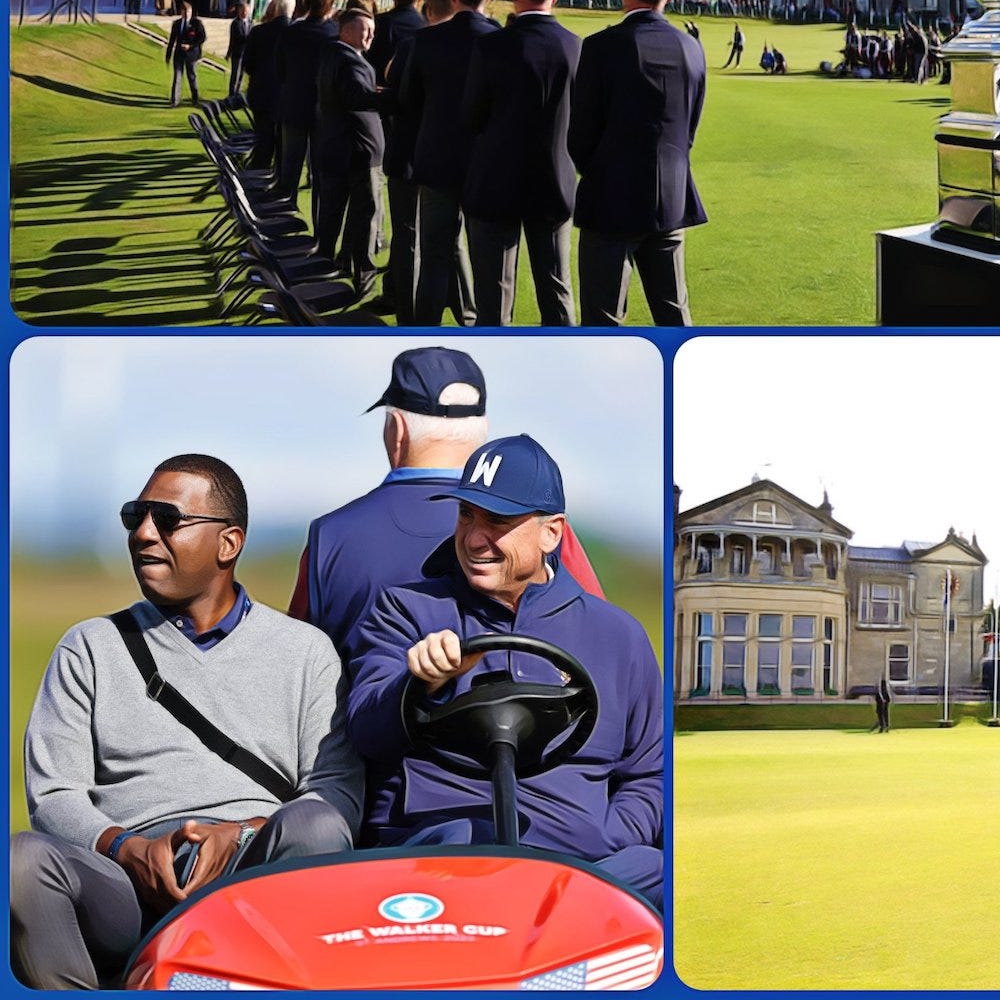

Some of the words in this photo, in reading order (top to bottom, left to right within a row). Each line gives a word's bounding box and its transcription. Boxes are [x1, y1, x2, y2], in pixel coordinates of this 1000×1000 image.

[469, 452, 503, 487] W
[321, 929, 365, 944] THE
[367, 924, 458, 937] WALKER
[462, 924, 508, 936] CUP
